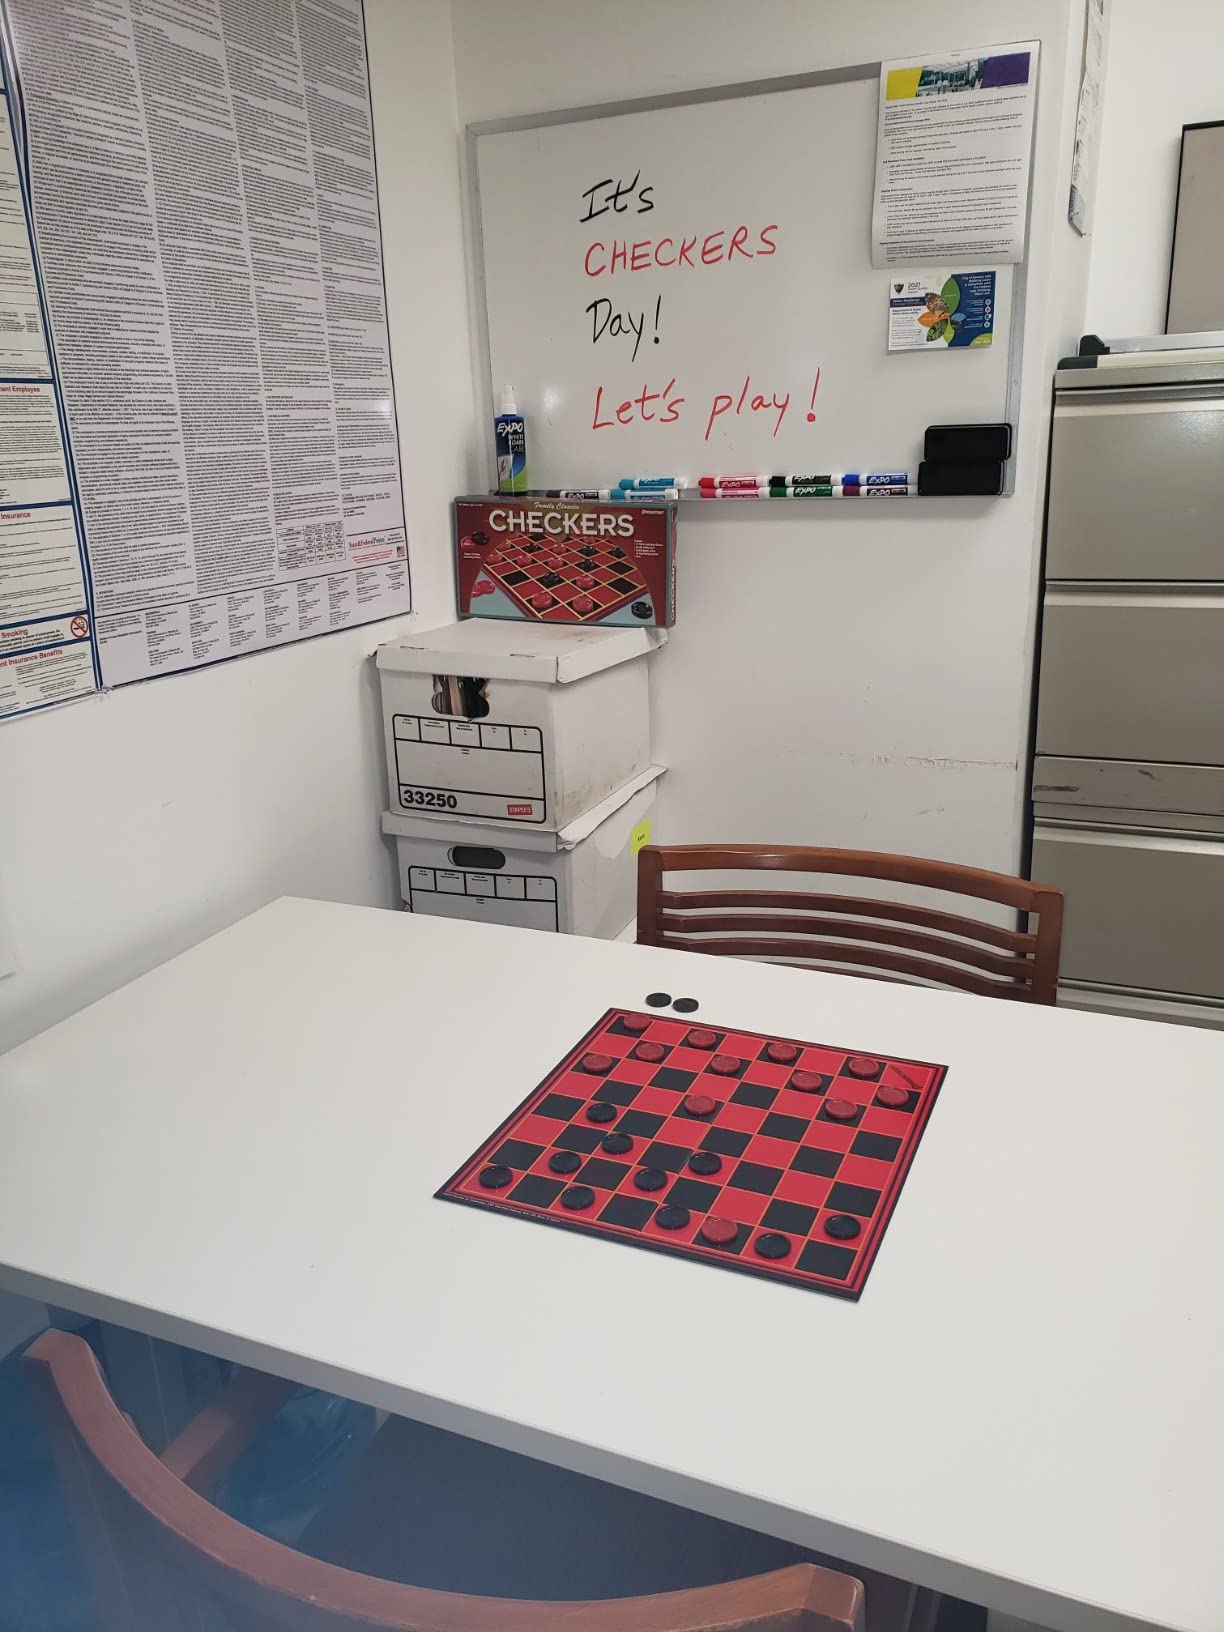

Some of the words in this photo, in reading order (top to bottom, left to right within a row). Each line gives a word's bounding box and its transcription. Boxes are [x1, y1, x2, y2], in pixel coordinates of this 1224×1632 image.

[579, 169, 654, 222] It's
[584, 225, 778, 277] CHECKERS
[585, 294, 661, 362] Day!
[592, 378, 685, 430] Let's
[496, 422, 524, 438] EXPO
[793, 474, 815, 482] EXPO
[868, 476, 890, 484] EXPO
[795, 487, 816, 495] EXPO
[534, 501, 555, 510] Family
[556, 502, 580, 510] Classics
[1, 511, 31, 519] Insurance
[488, 509, 635, 537] CHECKERS
[1, 628, 28, 638] Smoking
[8, 654, 38, 665] Insurance
[39, 649, 63, 659] Benefits
[403, 789, 457, 809] 33250
[508, 805, 531, 813] STAPLES
